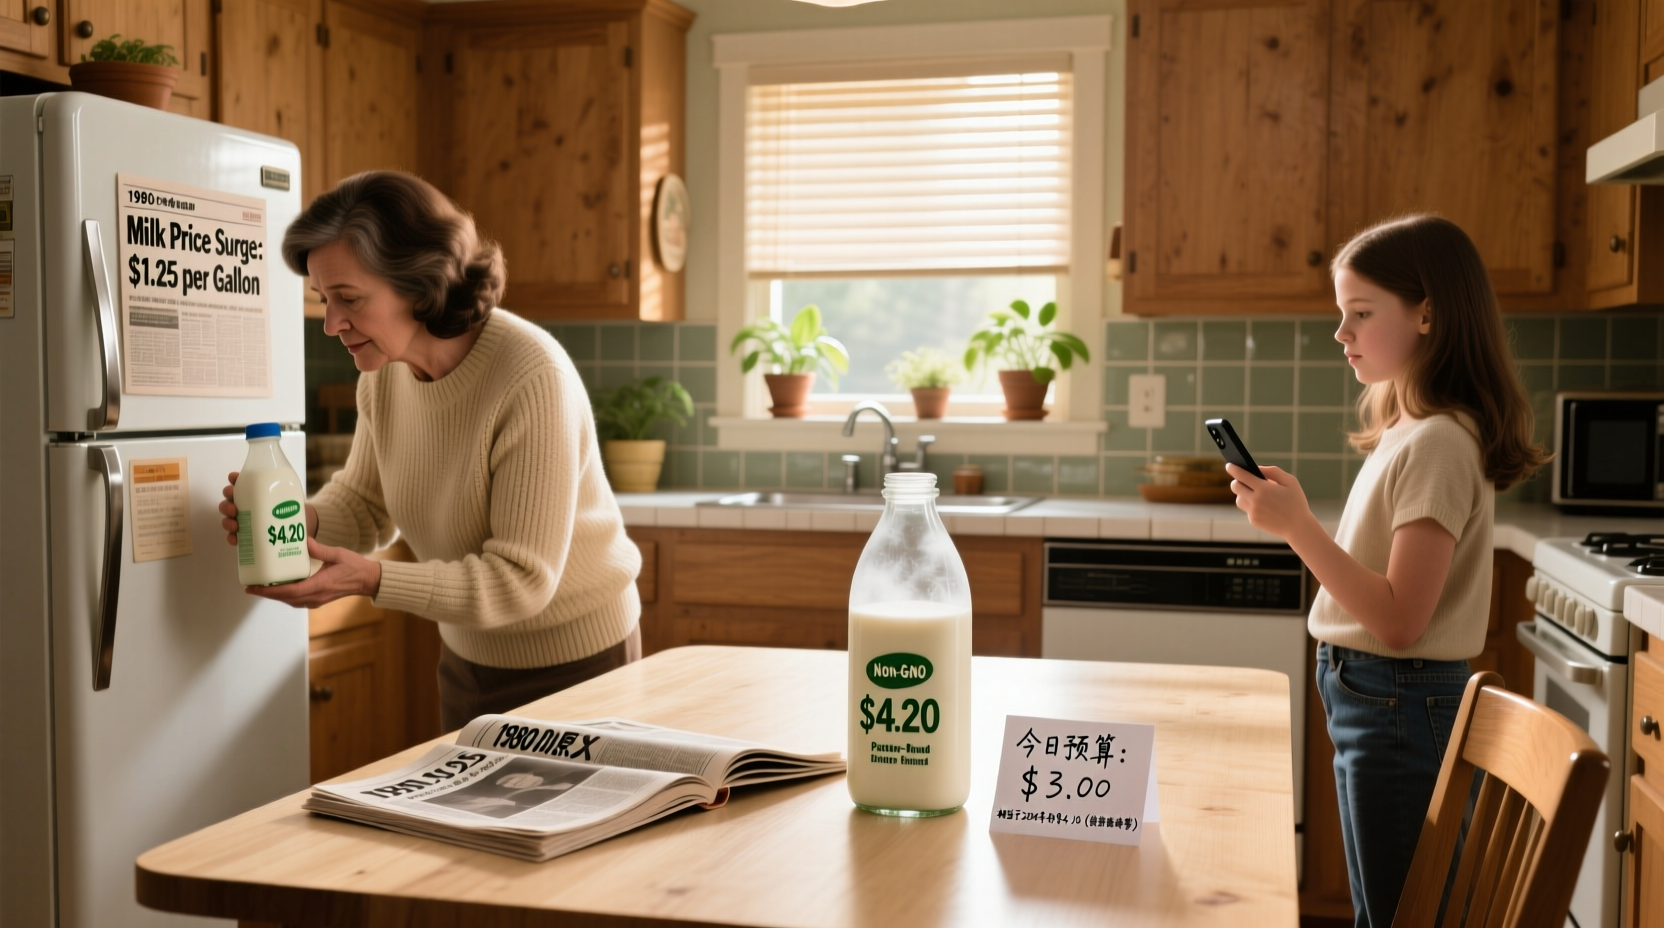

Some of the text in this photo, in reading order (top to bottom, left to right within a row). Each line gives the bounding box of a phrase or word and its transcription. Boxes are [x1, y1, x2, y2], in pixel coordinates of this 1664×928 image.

[127, 215, 263, 265] Milk Price Surge:
[128, 254, 260, 296] $1.25 per Gallon
[268, 522, 305, 546] $4.20
[860, 694, 940, 734] $4.20
